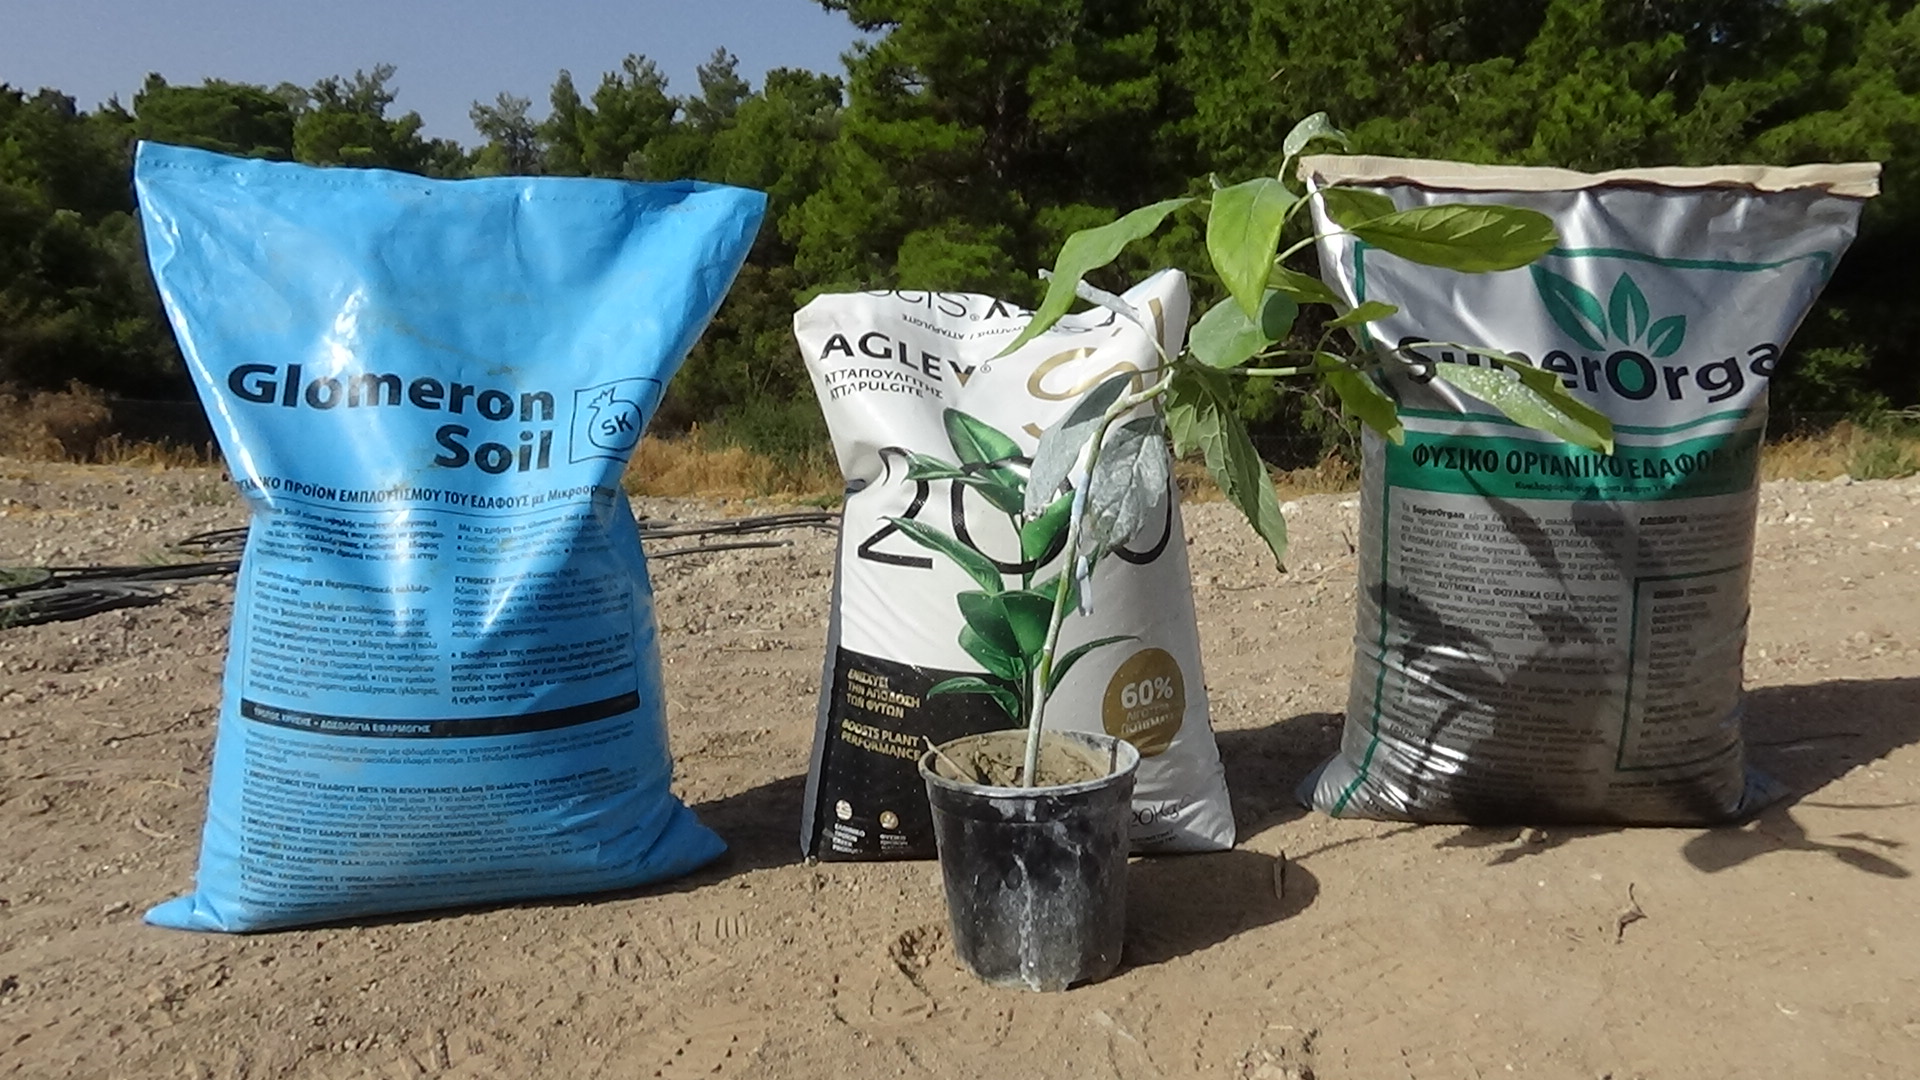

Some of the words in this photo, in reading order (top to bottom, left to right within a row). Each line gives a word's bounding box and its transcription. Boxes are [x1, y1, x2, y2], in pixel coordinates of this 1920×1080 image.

[228, 364, 554, 422] Glomeron
[600, 411, 636, 437] SK
[434, 423, 552, 474] Soil
[1413, 443, 1499, 473] ΦΥΣΙΚΟ
[1506, 448, 1622, 479] ΟΡΓΑΝΙΚΟ
[284, 478, 336, 501] ΠΡΟΪΟΝ
[339, 487, 441, 504] ΕΜΠΛΟΥΤΙΣΜΟΥ
[444, 489, 470, 506] ΤΟΥ
[471, 493, 530, 509] ΕΔΑΦΟΥΣ
[532, 494, 545, 507] με
[866, 686, 920, 708] ΑΠΟΔΟΣΗ
[1121, 676, 1174, 709] 60%
[866, 700, 904, 719] ΦΥΤΩΝ
[372, 723, 432, 735] ΕΦΑΡΜΟΓΗΣ
[842, 719, 880, 741] BOOSTS
[882, 729, 919, 747] PLANT
[841, 732, 921, 762] PERFORMANCE
